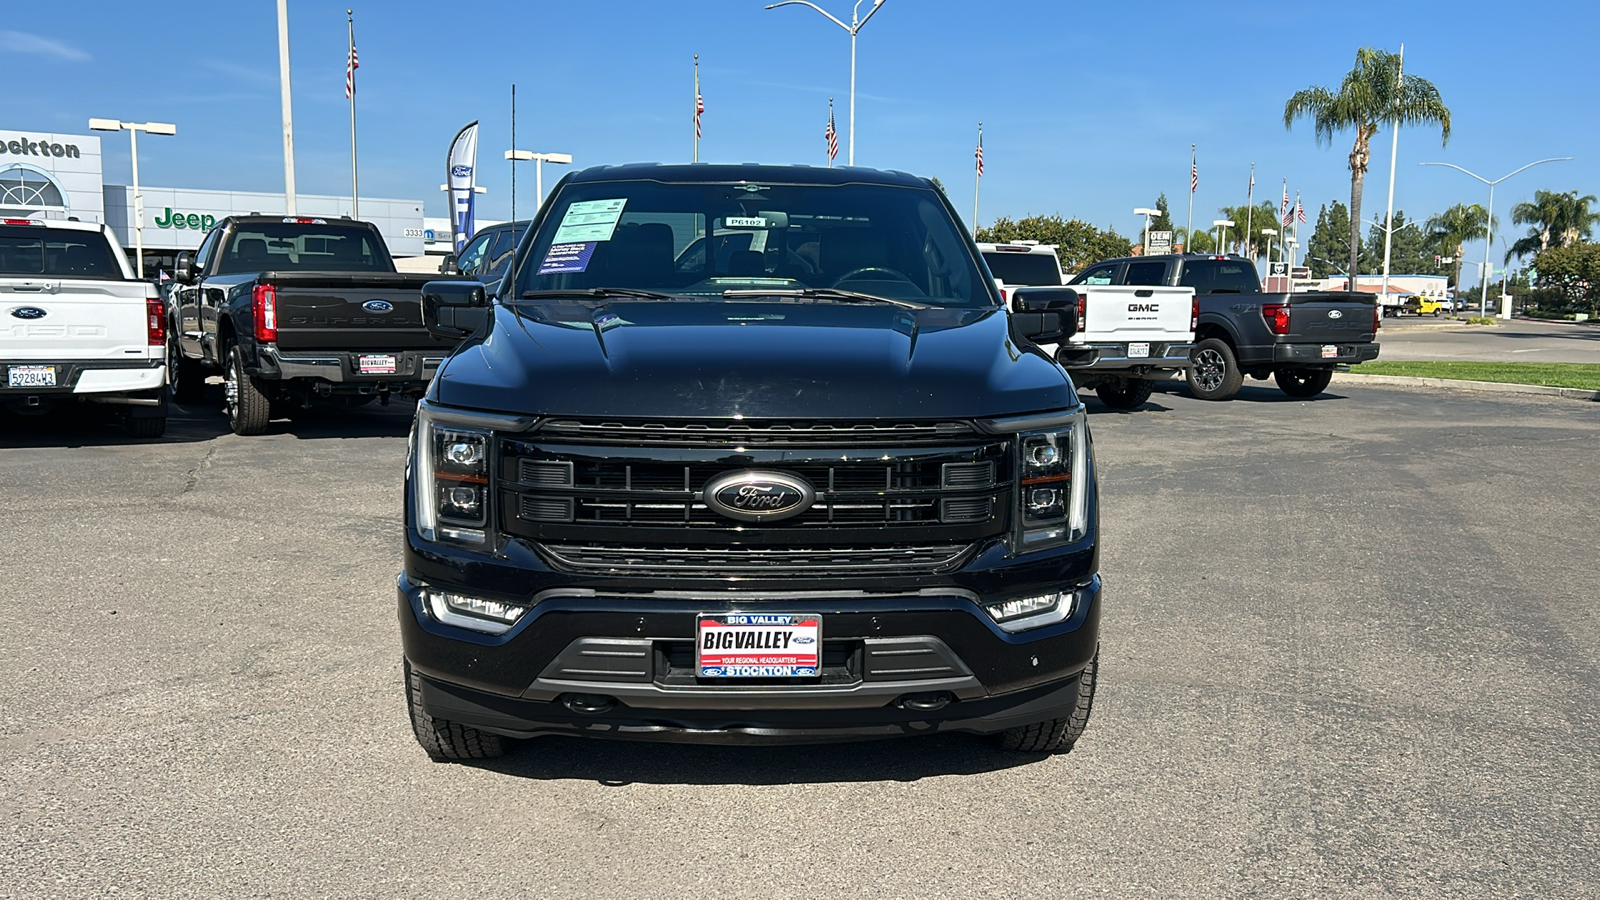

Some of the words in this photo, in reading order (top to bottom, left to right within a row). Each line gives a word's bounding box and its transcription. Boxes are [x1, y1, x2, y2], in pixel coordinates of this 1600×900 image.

[453, 166, 472, 176] Ford
[155, 207, 216, 232] Jeep
[405, 229, 423, 237] 3333
[1151, 232, 1170, 240] OEM
[1128, 304, 1159, 312] GMC
[734, 485, 785, 508] Ford
[727, 616, 747, 624] BIG
[750, 616, 791, 624] VALLEY
[703, 631, 793, 649] BIGVALLEY
[726, 666, 792, 676] STOCKTON
